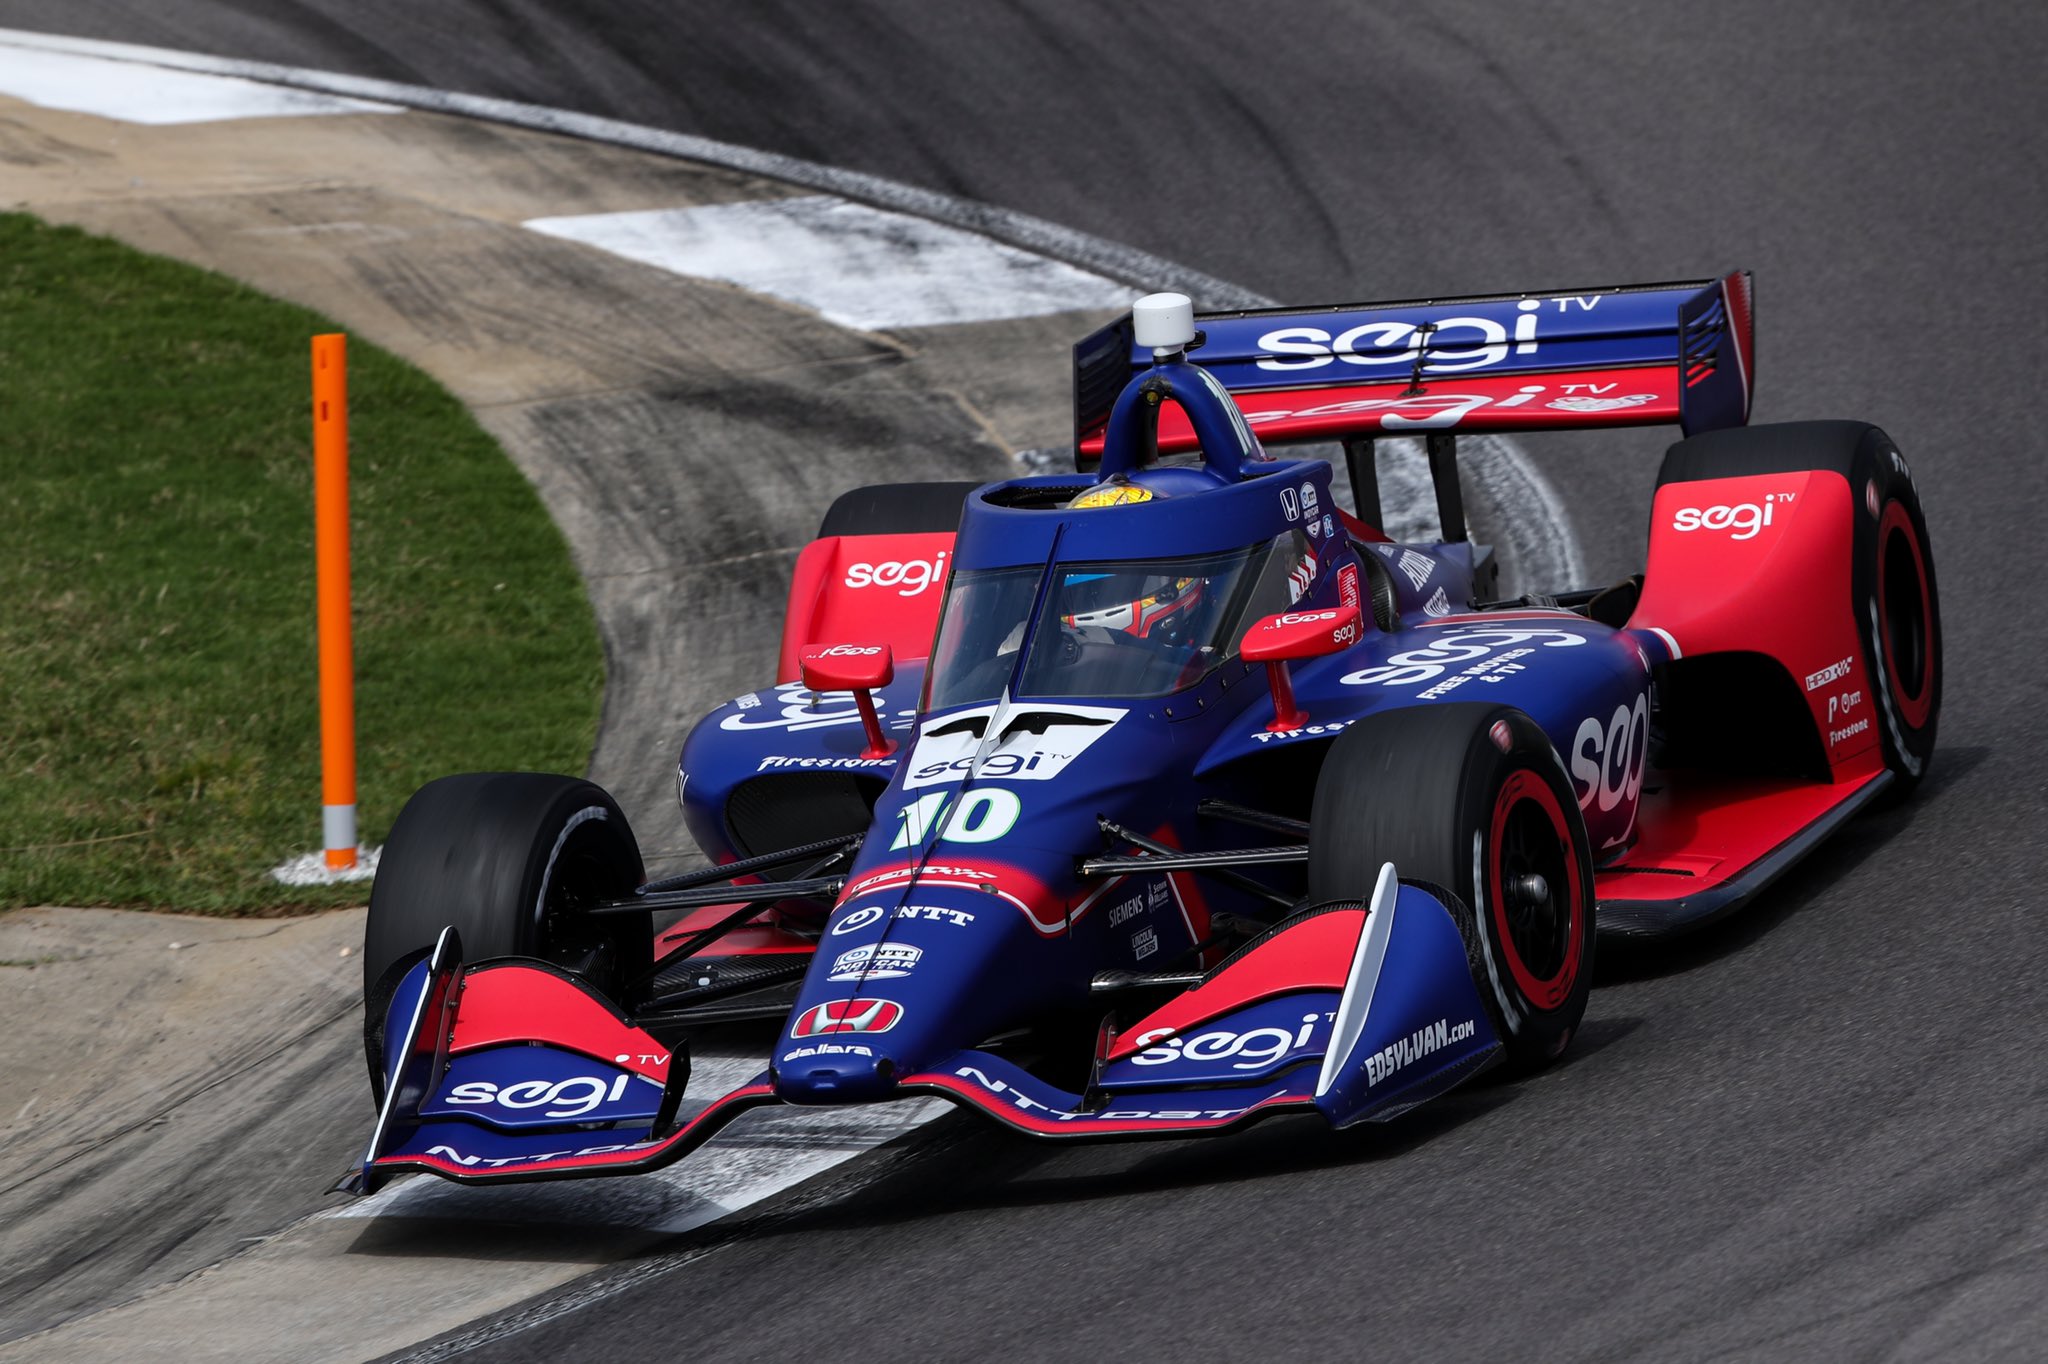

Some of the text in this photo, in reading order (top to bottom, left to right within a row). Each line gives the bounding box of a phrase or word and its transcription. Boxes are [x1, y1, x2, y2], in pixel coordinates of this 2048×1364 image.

[1256, 295, 1601, 371] segi TV
[1560, 383, 1618, 394] TV
[1673, 493, 1795, 540] segi TV
[845, 551, 946, 596] segi
[1333, 619, 1356, 645] segi
[1492, 663, 1526, 674] TV
[1807, 669, 1832, 689] HPD
[1416, 676, 1473, 699] FREE
[1830, 718, 1868, 747] Firestone
[757, 755, 898, 772] Firestone
[914, 751, 1044, 778] segi
[889, 787, 1022, 852] 10
[890, 906, 975, 927] NTT
[1109, 894, 1144, 928] SIEMENS
[783, 1044, 873, 1062] dallara
[1131, 1012, 1337, 1070] segi T
[445, 1054, 670, 1118] segi TV
[955, 1066, 1095, 1120] NTT
[425, 1145, 572, 1167] NTT
